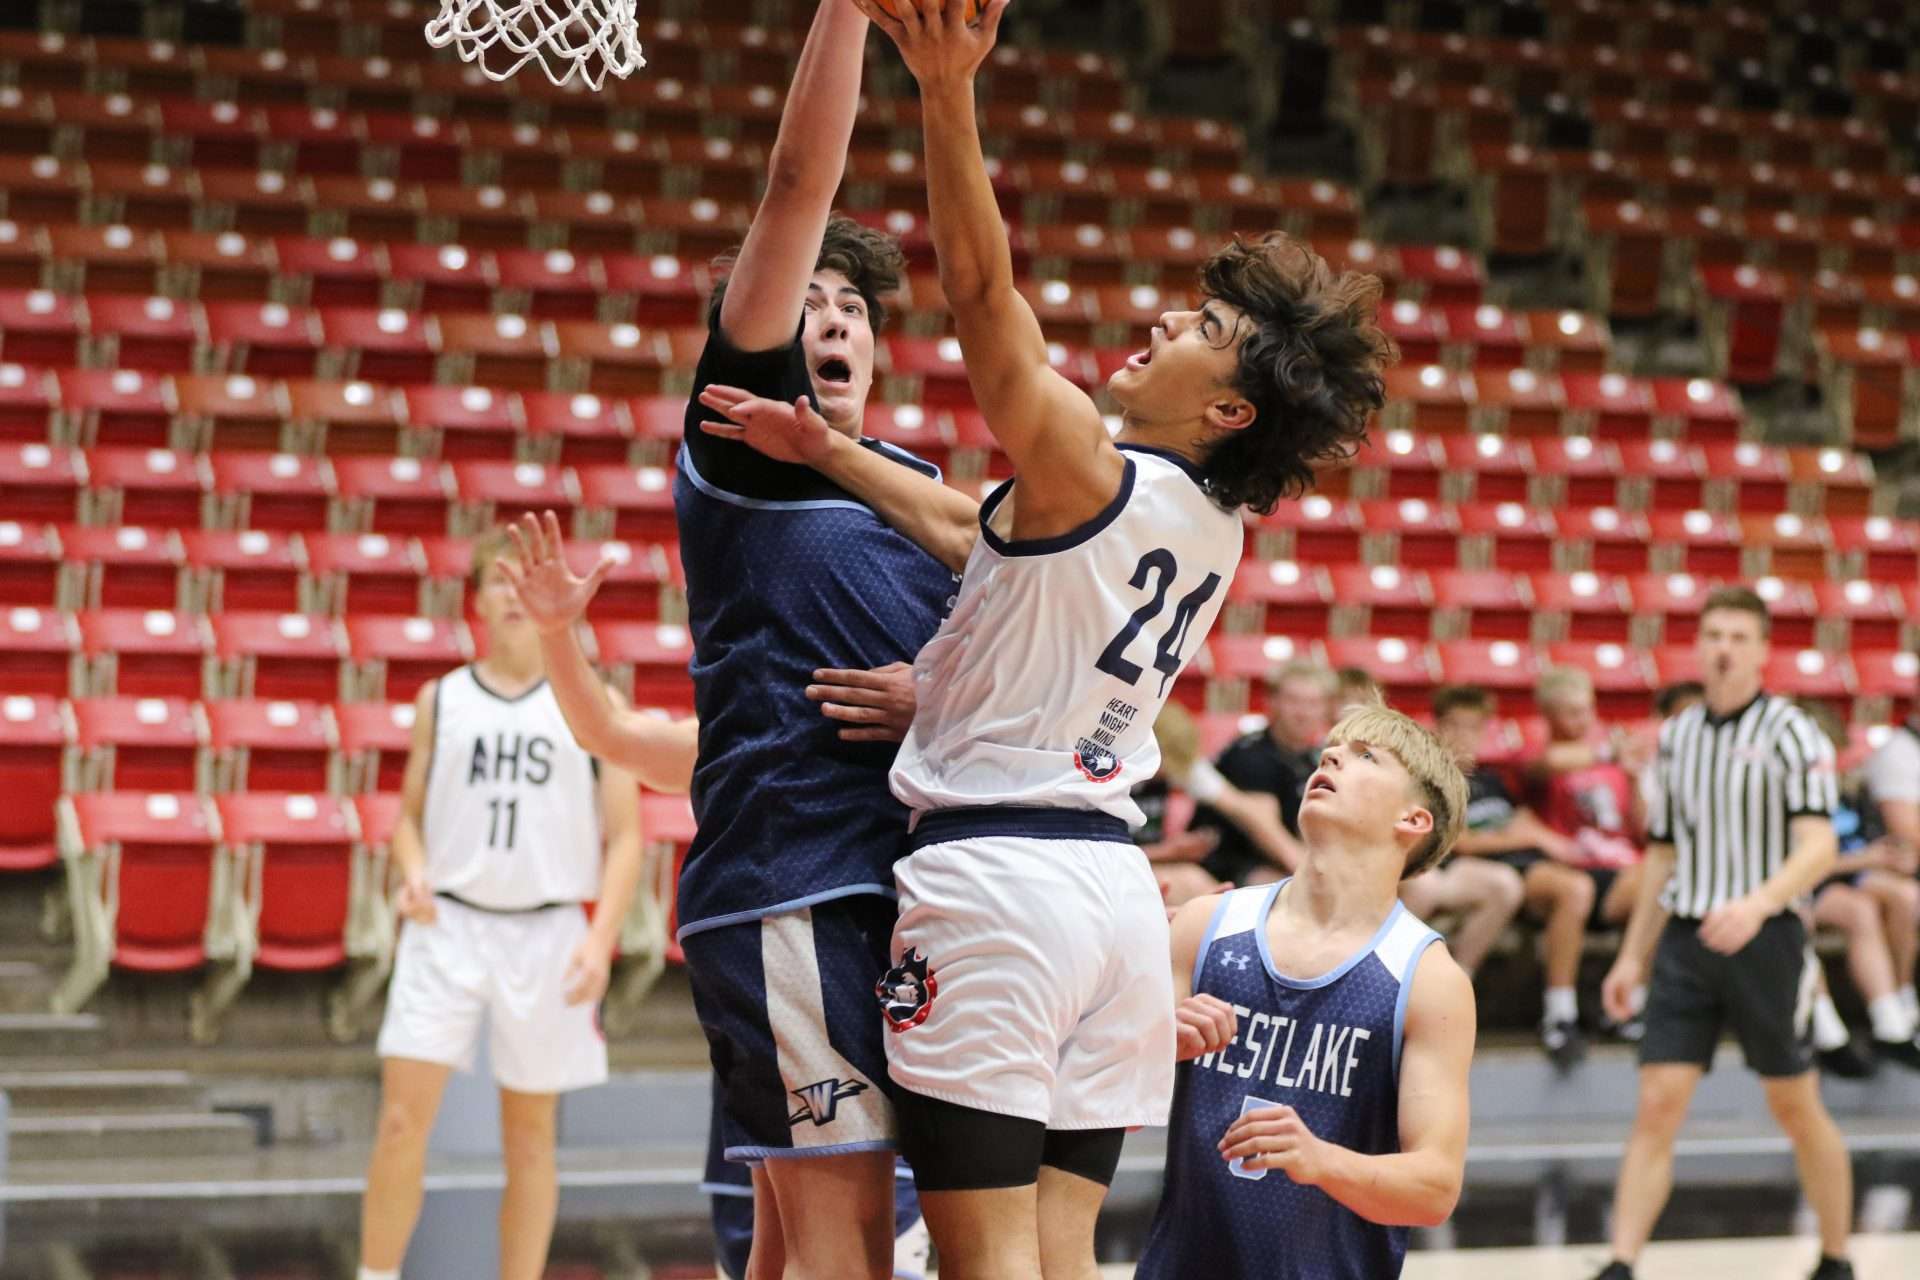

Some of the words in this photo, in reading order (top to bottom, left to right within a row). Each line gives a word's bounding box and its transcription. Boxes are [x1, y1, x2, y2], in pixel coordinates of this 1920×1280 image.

[1094, 547, 1222, 699] 24
[1099, 711, 1130, 734] MIGHT
[1106, 697, 1138, 721] HEART
[1091, 727, 1116, 747] MIND
[467, 732, 554, 787] AHS
[488, 798, 518, 849] 11
